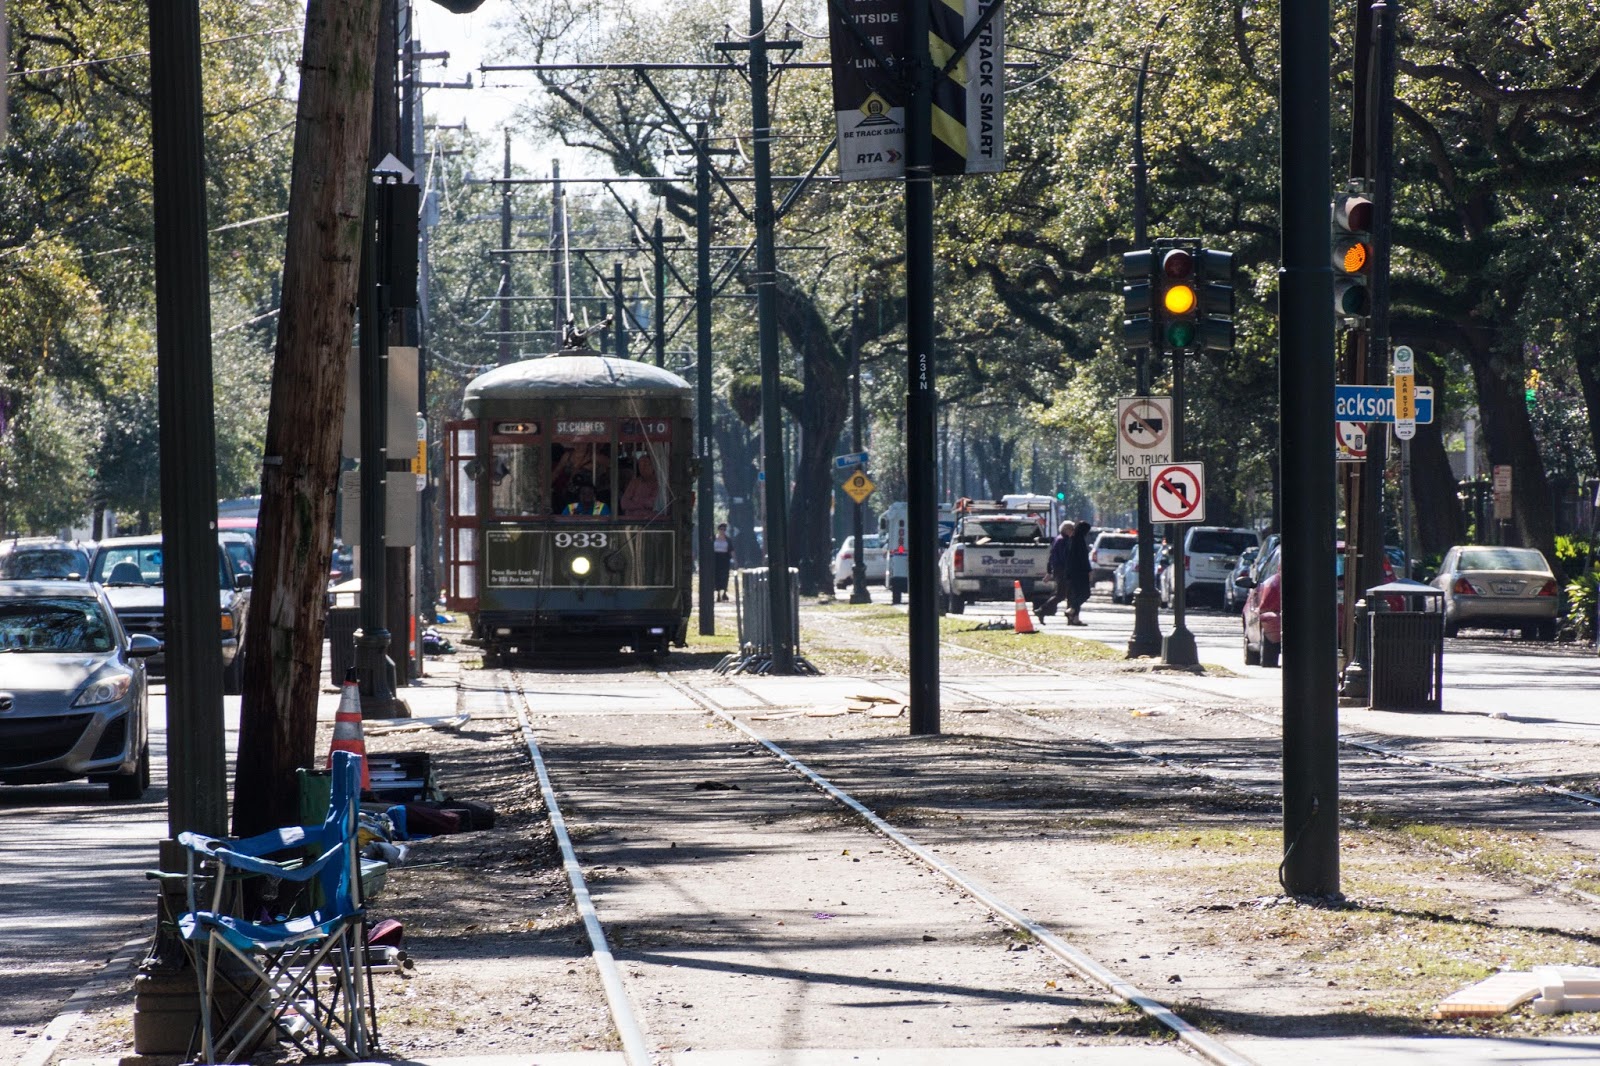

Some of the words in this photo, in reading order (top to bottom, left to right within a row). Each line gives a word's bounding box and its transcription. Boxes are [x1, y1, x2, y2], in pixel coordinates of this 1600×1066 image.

[979, 23, 993, 87] TRACK
[855, 57, 894, 69] LINS
[856, 129, 882, 138] TRACK
[883, 127, 905, 135] SMAR
[980, 93, 993, 159] SMART
[857, 152, 883, 164] RTA
[919, 353, 928, 390] 234N
[1336, 392, 1396, 417] ackson
[1121, 454, 1135, 465] NO
[1140, 454, 1169, 465] TRUCK
[1128, 466, 1149, 477] ROU
[555, 532, 607, 548] 933
